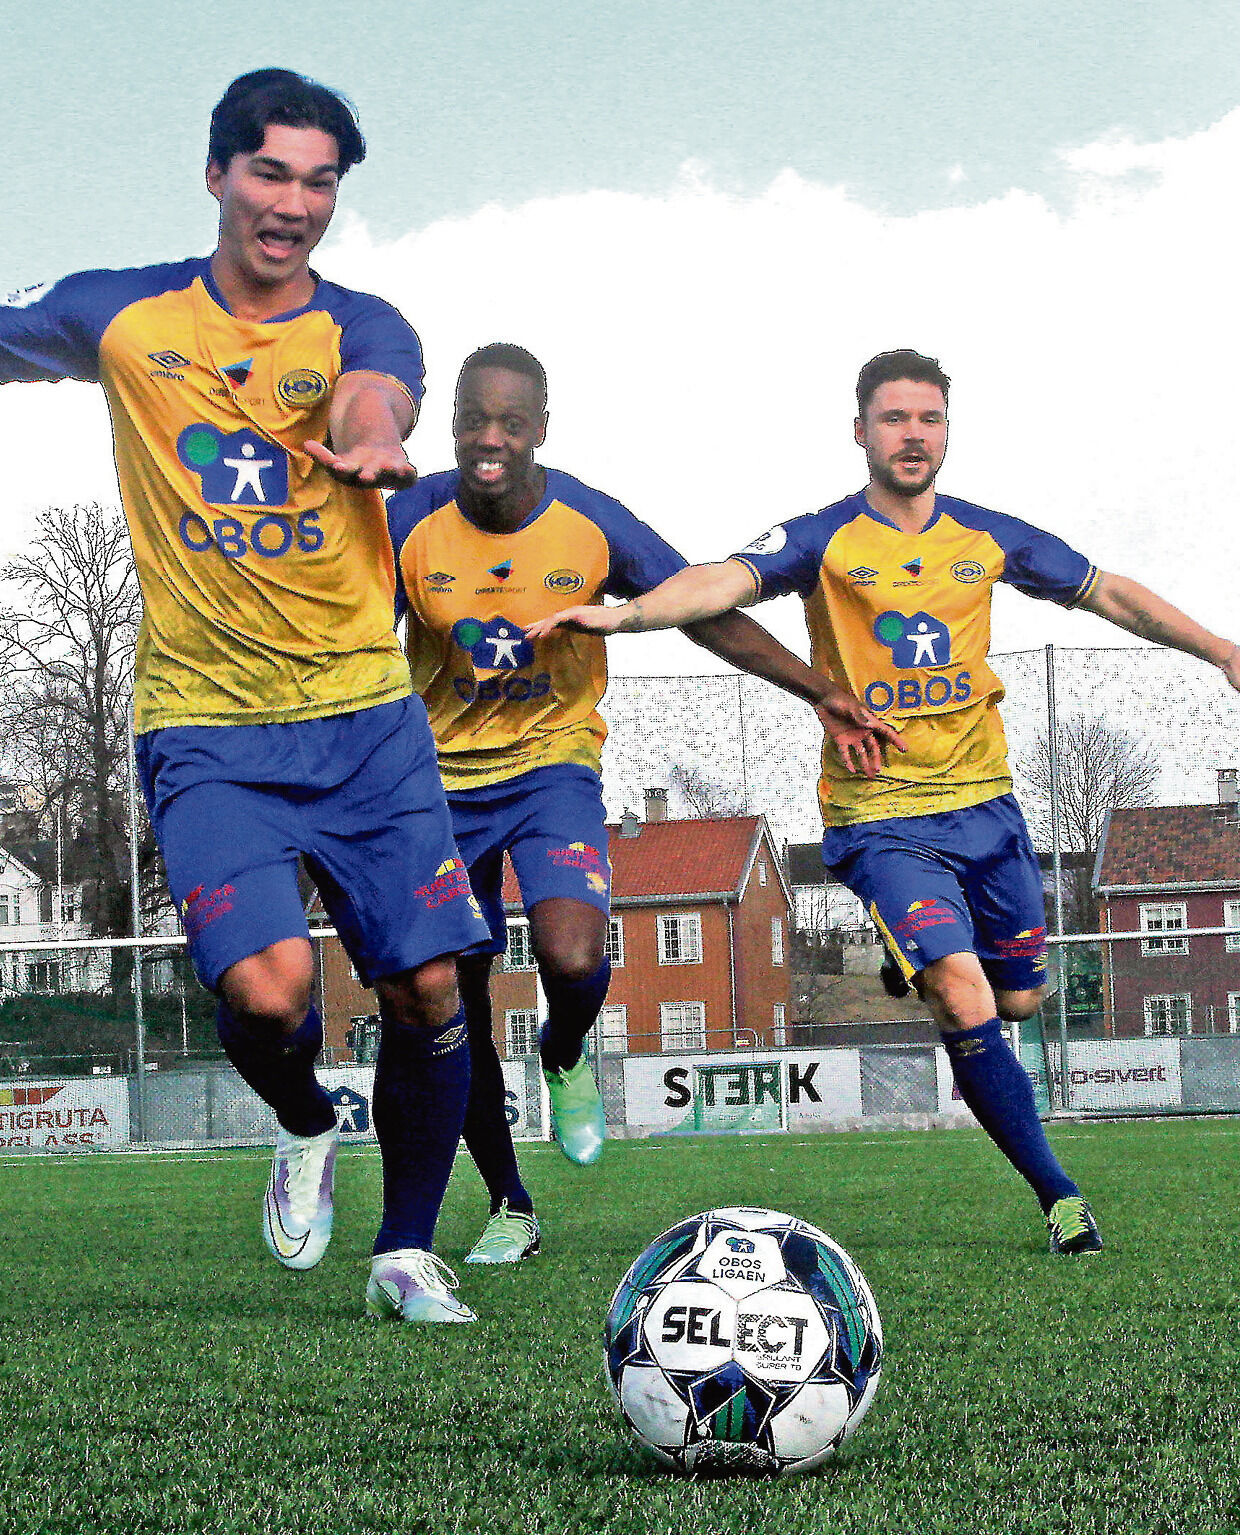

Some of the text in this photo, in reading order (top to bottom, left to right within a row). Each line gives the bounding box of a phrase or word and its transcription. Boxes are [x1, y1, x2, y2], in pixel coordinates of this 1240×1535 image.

[178, 509, 325, 559] OBOS
[454, 672, 552, 703] OBOS
[864, 671, 972, 712] OBOS
[712, 1269, 766, 1282] LIGAEN
[719, 1257, 762, 1269] OBOS
[662, 1306, 809, 1355] SELECT
